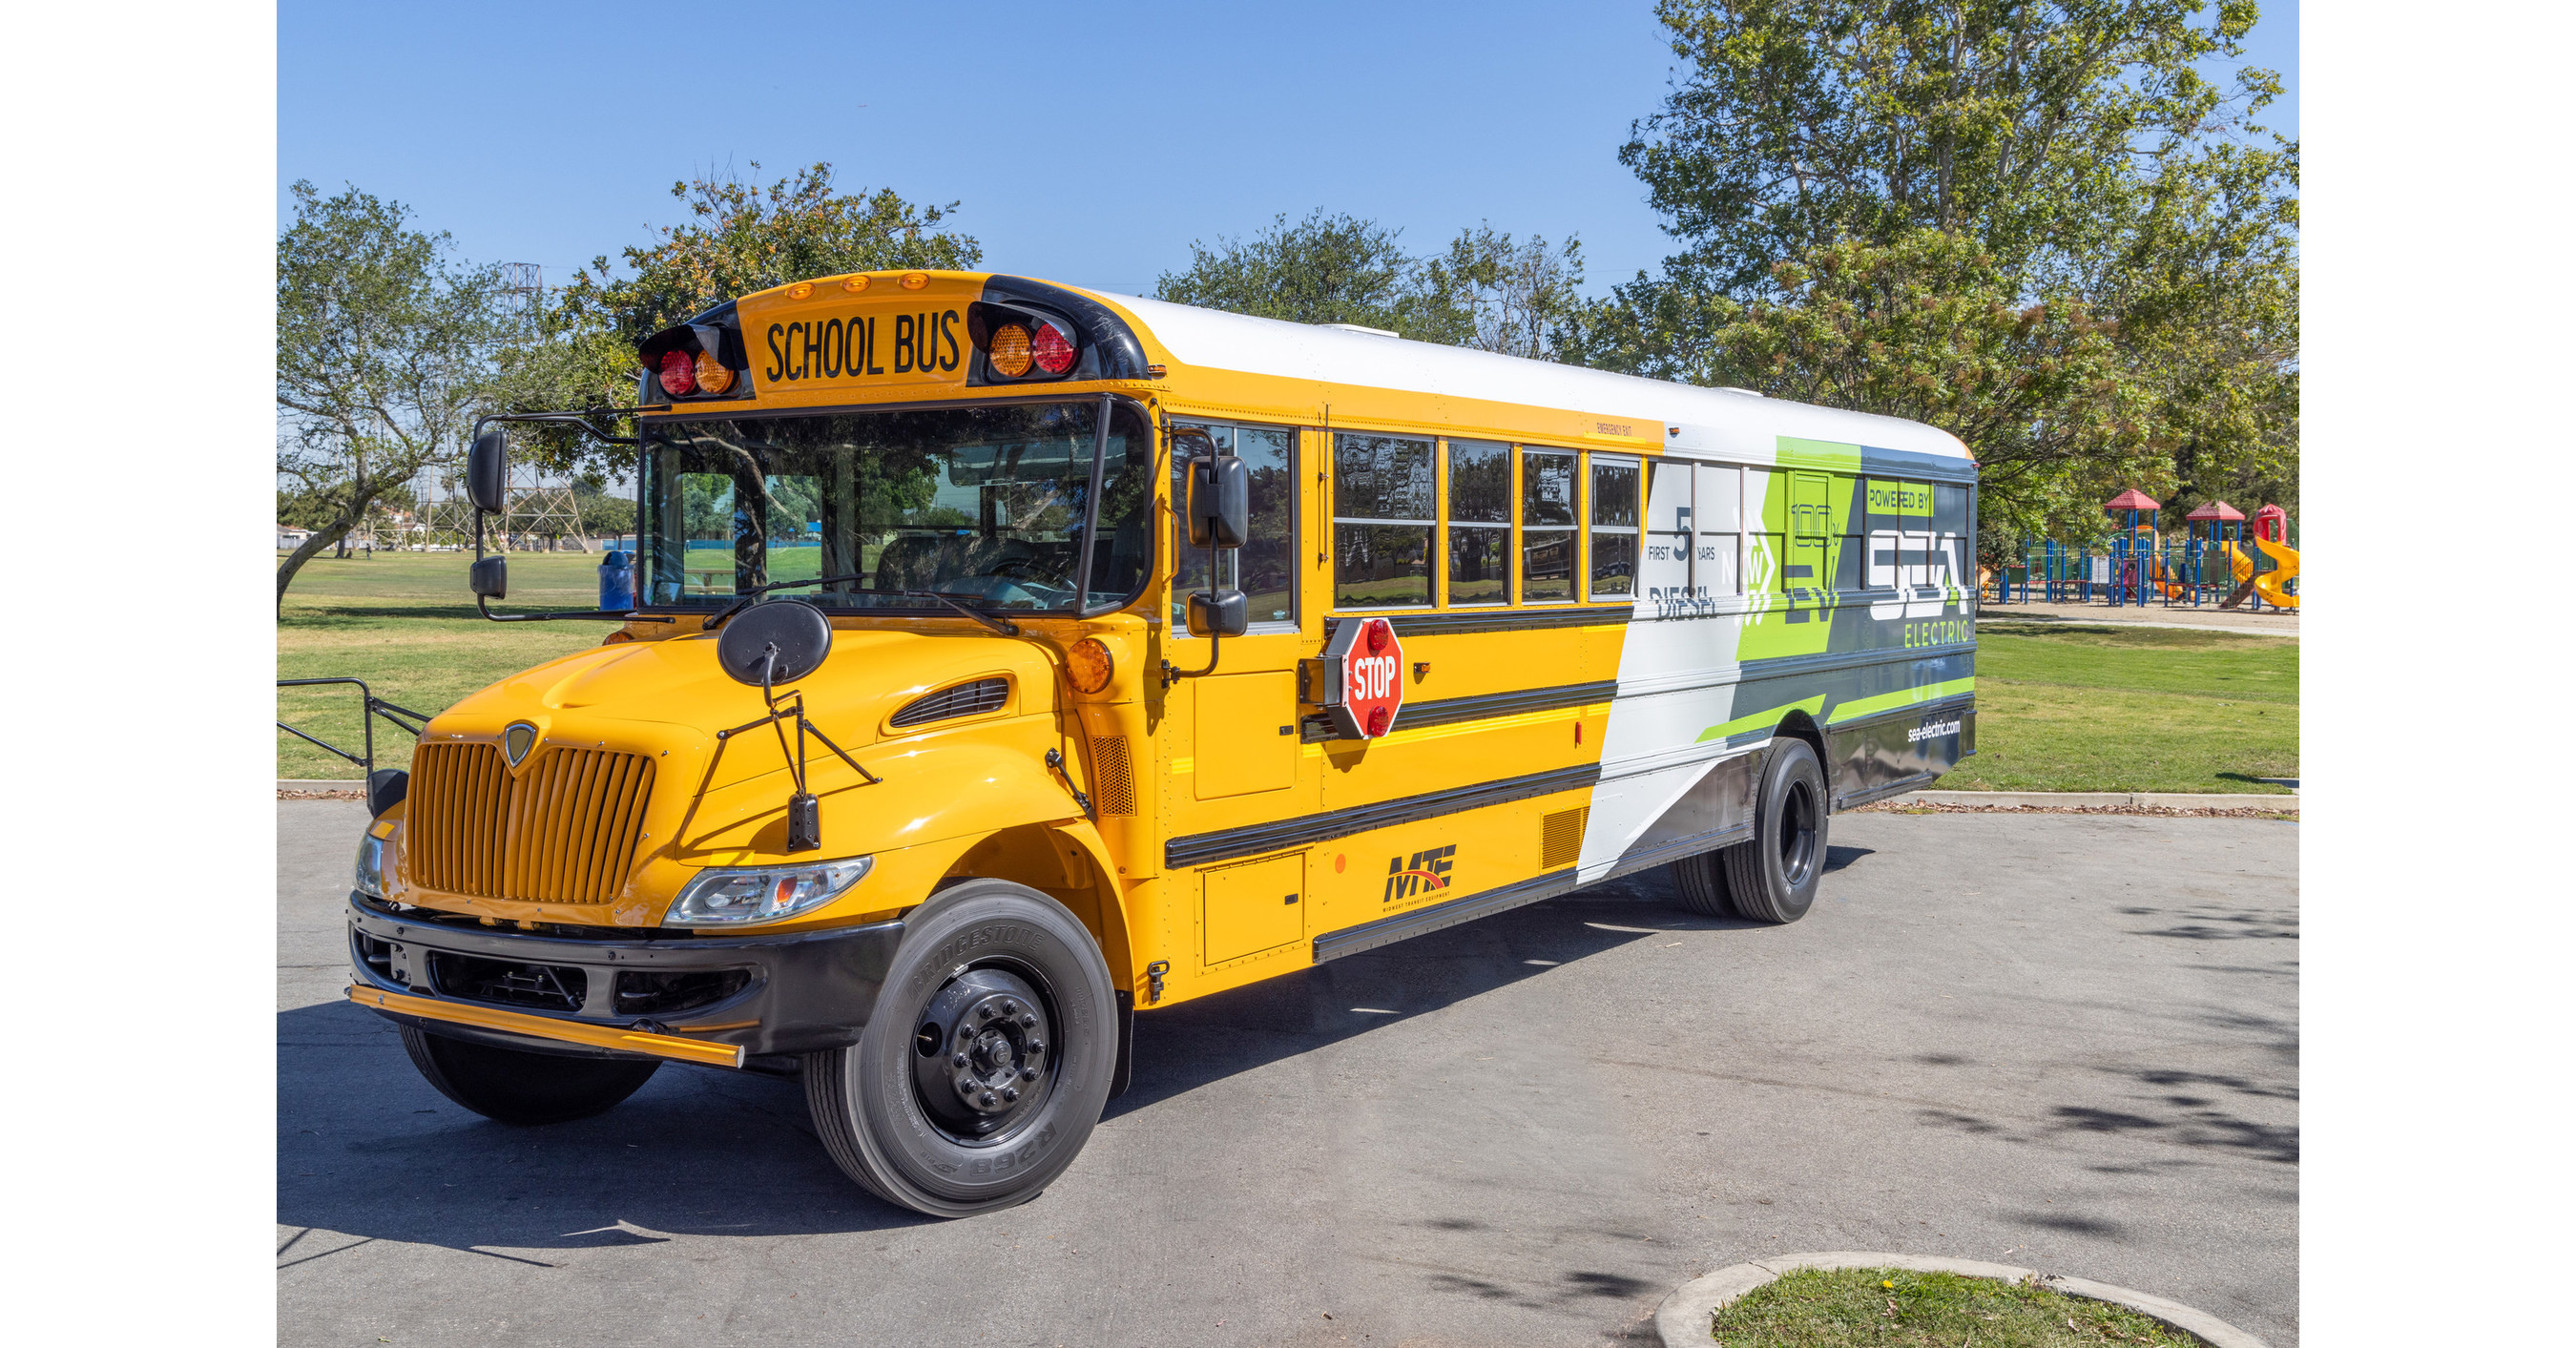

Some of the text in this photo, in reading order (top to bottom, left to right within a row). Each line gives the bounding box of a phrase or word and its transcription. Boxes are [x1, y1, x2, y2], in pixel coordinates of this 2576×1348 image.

[766, 310, 960, 382] SCHOOL BUS
[1597, 422, 1631, 437] EMERGENCY EXIT
[1870, 488, 1930, 509] POWERED BY
[1649, 507, 1715, 561] FIRST 5 YARS
[1868, 529, 1968, 620] SEA
[1904, 620, 1968, 648] ELECTRIC
[1354, 655, 1396, 701] STOP
[1908, 719, 1961, 742] sea-electric.com
[1383, 843, 1457, 902] MTE
[1382, 891, 1450, 912] MIDWEST TRANSIT EQUIPMENT
[907, 924, 1045, 1004] BRIDGESTONE
[970, 1121, 1057, 1176] R268
